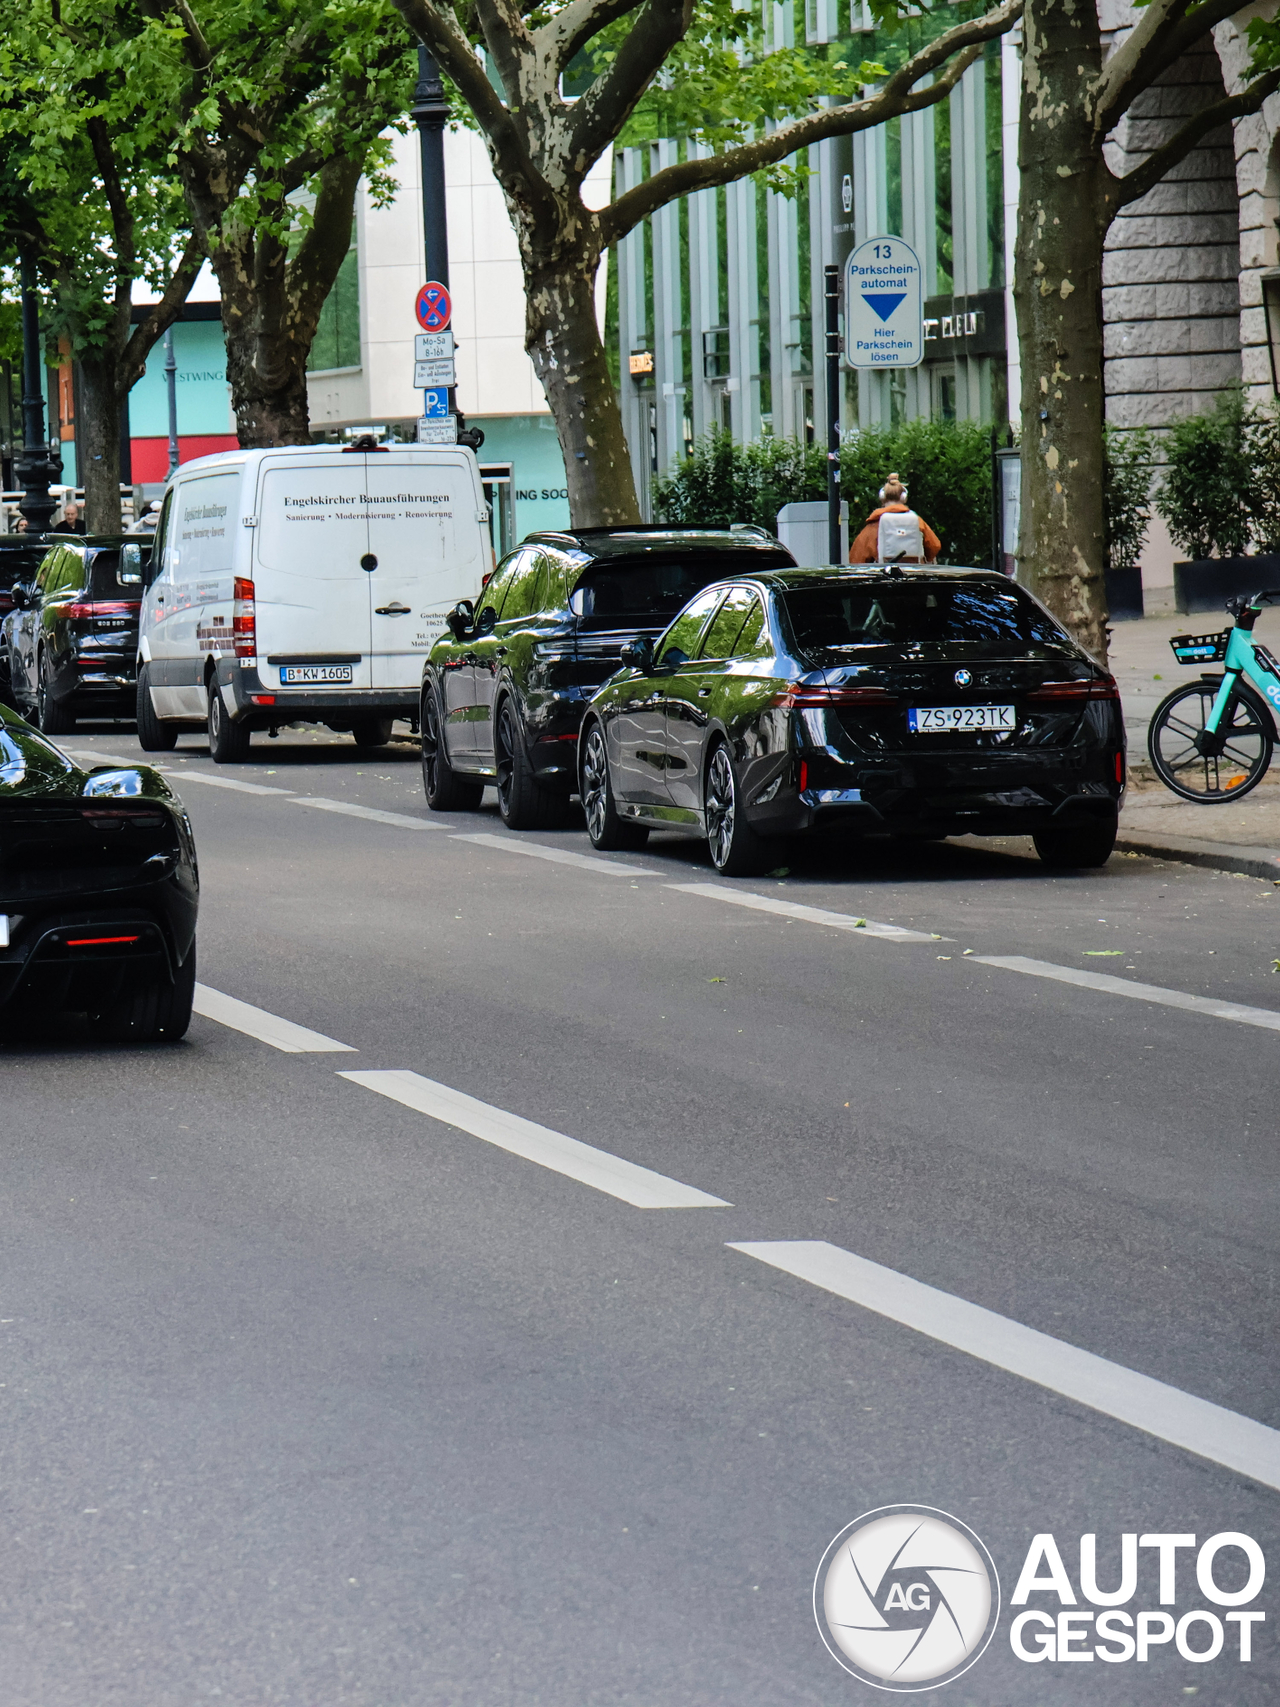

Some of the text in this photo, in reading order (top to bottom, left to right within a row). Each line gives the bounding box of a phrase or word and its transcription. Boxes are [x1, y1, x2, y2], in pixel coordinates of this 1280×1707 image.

[873, 245, 892, 259] 13
[851, 264, 917, 275] Parkschein-
[861, 278, 907, 288] automat
[874, 328, 895, 337] Hier
[423, 336, 446, 346] Mo-Sa
[856, 340, 912, 350] Parkschein
[426, 348, 444, 357] 8-16h
[871, 352, 898, 361] lösen
[426, 392, 438, 414] P
[541, 489, 569, 500] SOO
[284, 493, 450, 508] Engelskircher Bauausführungen
[286, 511, 453, 522] Sanierung Modernisierung Renovierung
[288, 667, 350, 680] B KW 1605
[921, 707, 1010, 728] ZS 923TK
